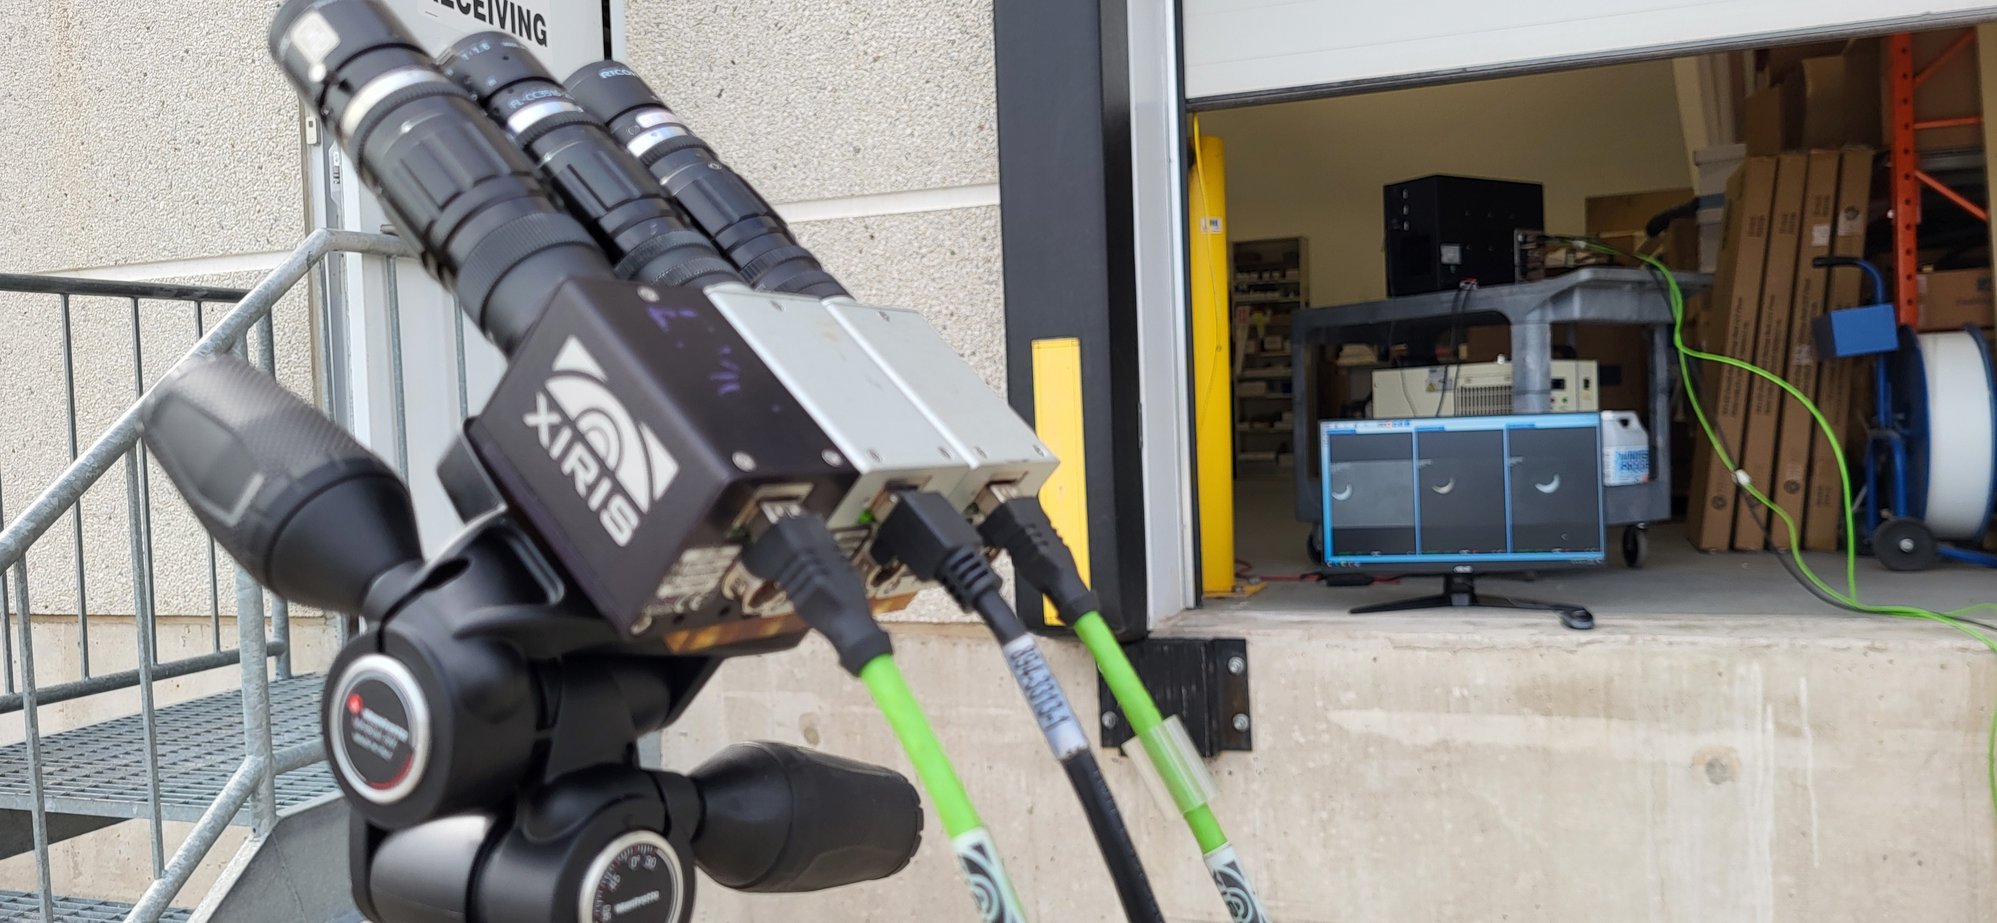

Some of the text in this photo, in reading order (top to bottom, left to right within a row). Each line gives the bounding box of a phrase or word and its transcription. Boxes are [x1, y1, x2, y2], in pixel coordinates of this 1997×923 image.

[433, 0, 548, 47] CEIVING
[600, 68, 640, 79] RICO
[522, 391, 640, 547] XIRIS
